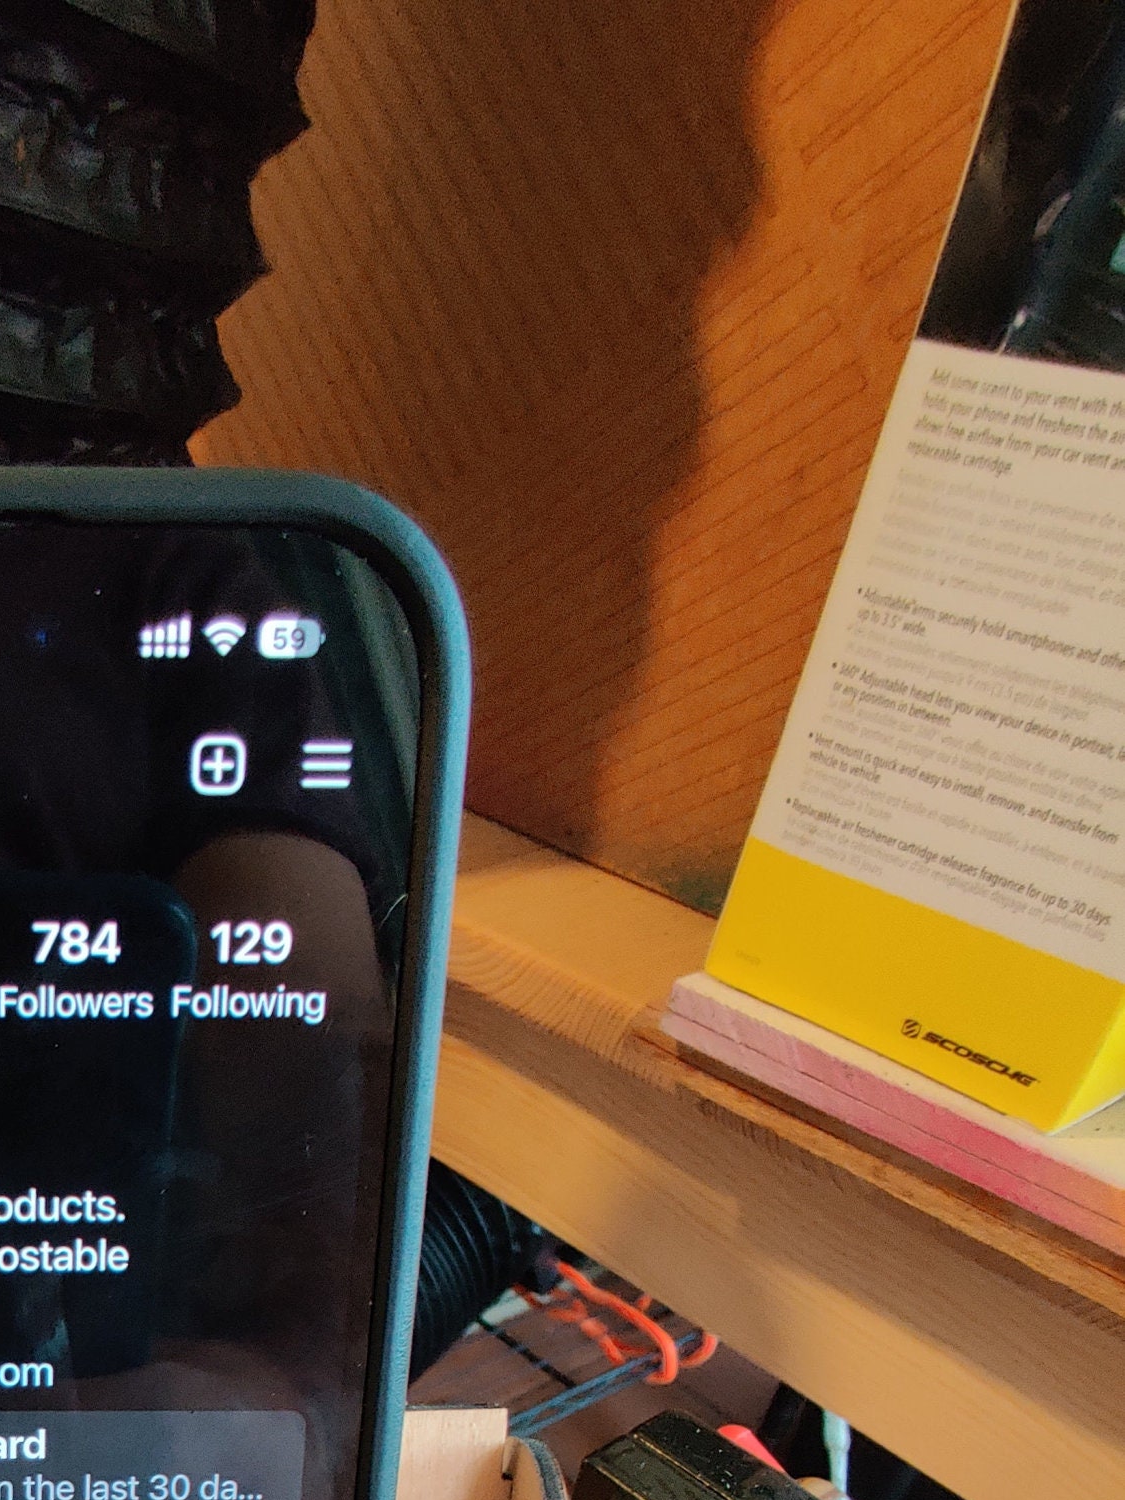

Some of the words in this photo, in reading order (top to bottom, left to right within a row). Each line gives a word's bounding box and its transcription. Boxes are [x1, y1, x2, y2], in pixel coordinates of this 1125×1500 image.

[929, 367, 951, 387] Add
[949, 376, 979, 391] some
[1009, 384, 1023, 401] to
[1021, 389, 1053, 407] your
[1052, 394, 1081, 410] vent
[1080, 397, 1108, 414] with
[946, 401, 973, 417] your
[971, 403, 1010, 424] phone
[1010, 411, 1037, 429] and
[1035, 412, 1086, 438] freshens
[1086, 422, 1109, 442] the
[965, 426, 1005, 447] airflow
[1004, 431, 1033, 452] from
[1031, 442, 1062, 460] your
[1061, 447, 1082, 463] car
[1081, 452, 1111, 468] vent
[856, 607, 871, 623] up
[869, 608, 881, 624] to
[863, 586, 914, 613] Adjustable
[936, 610, 979, 634] securely
[978, 618, 1007, 638] hold
[1004, 628, 1076, 657] smartphones
[1074, 647, 1102, 664] and
[273, 627, 306, 651] 59
[831, 680, 843, 692] or
[841, 684, 860, 703] any
[856, 689, 897, 710] position
[895, 700, 908, 713] in
[907, 702, 951, 727] between.
[858, 668, 909, 695] Adjustable
[908, 683, 937, 703] head
[933, 690, 954, 709] lets
[950, 700, 975, 716] you
[973, 706, 1000, 722] view
[996, 713, 1025, 730] your
[1022, 718, 1059, 740] device
[1057, 728, 1072, 744] in
[1069, 735, 1115, 760] portrait,
[808, 749, 839, 769] vehicle
[837, 759, 849, 773] to
[813, 731, 834, 749] Vent
[832, 741, 864, 760] mount
[862, 751, 873, 764] is
[871, 754, 898, 772] quick
[897, 763, 920, 779] and
[917, 769, 942, 789] easy
[939, 775, 953, 790] to
[951, 778, 985, 802] install,
[985, 792, 1026, 816] remove,
[1026, 806, 1052, 822] and
[1048, 812, 1092, 835] transfer
[1090, 823, 1119, 844] from
[791, 797, 841, 827] Replaceable
[839, 819, 855, 831] air
[853, 820, 898, 847] freshener
[896, 839, 939, 864] cartridge
[938, 854, 979, 877] releases
[978, 865, 1026, 894] fragrance
[1024, 881, 1042, 899] for
[1039, 891, 1058, 908] up
[1055, 895, 1070, 910] to
[1067, 898, 1088, 916] 30
[31, 921, 121, 964] 784
[210, 921, 293, 964] 129
[170, 984, 326, 1025] Following
[922, 1031, 1036, 1086] SCOSCHE
